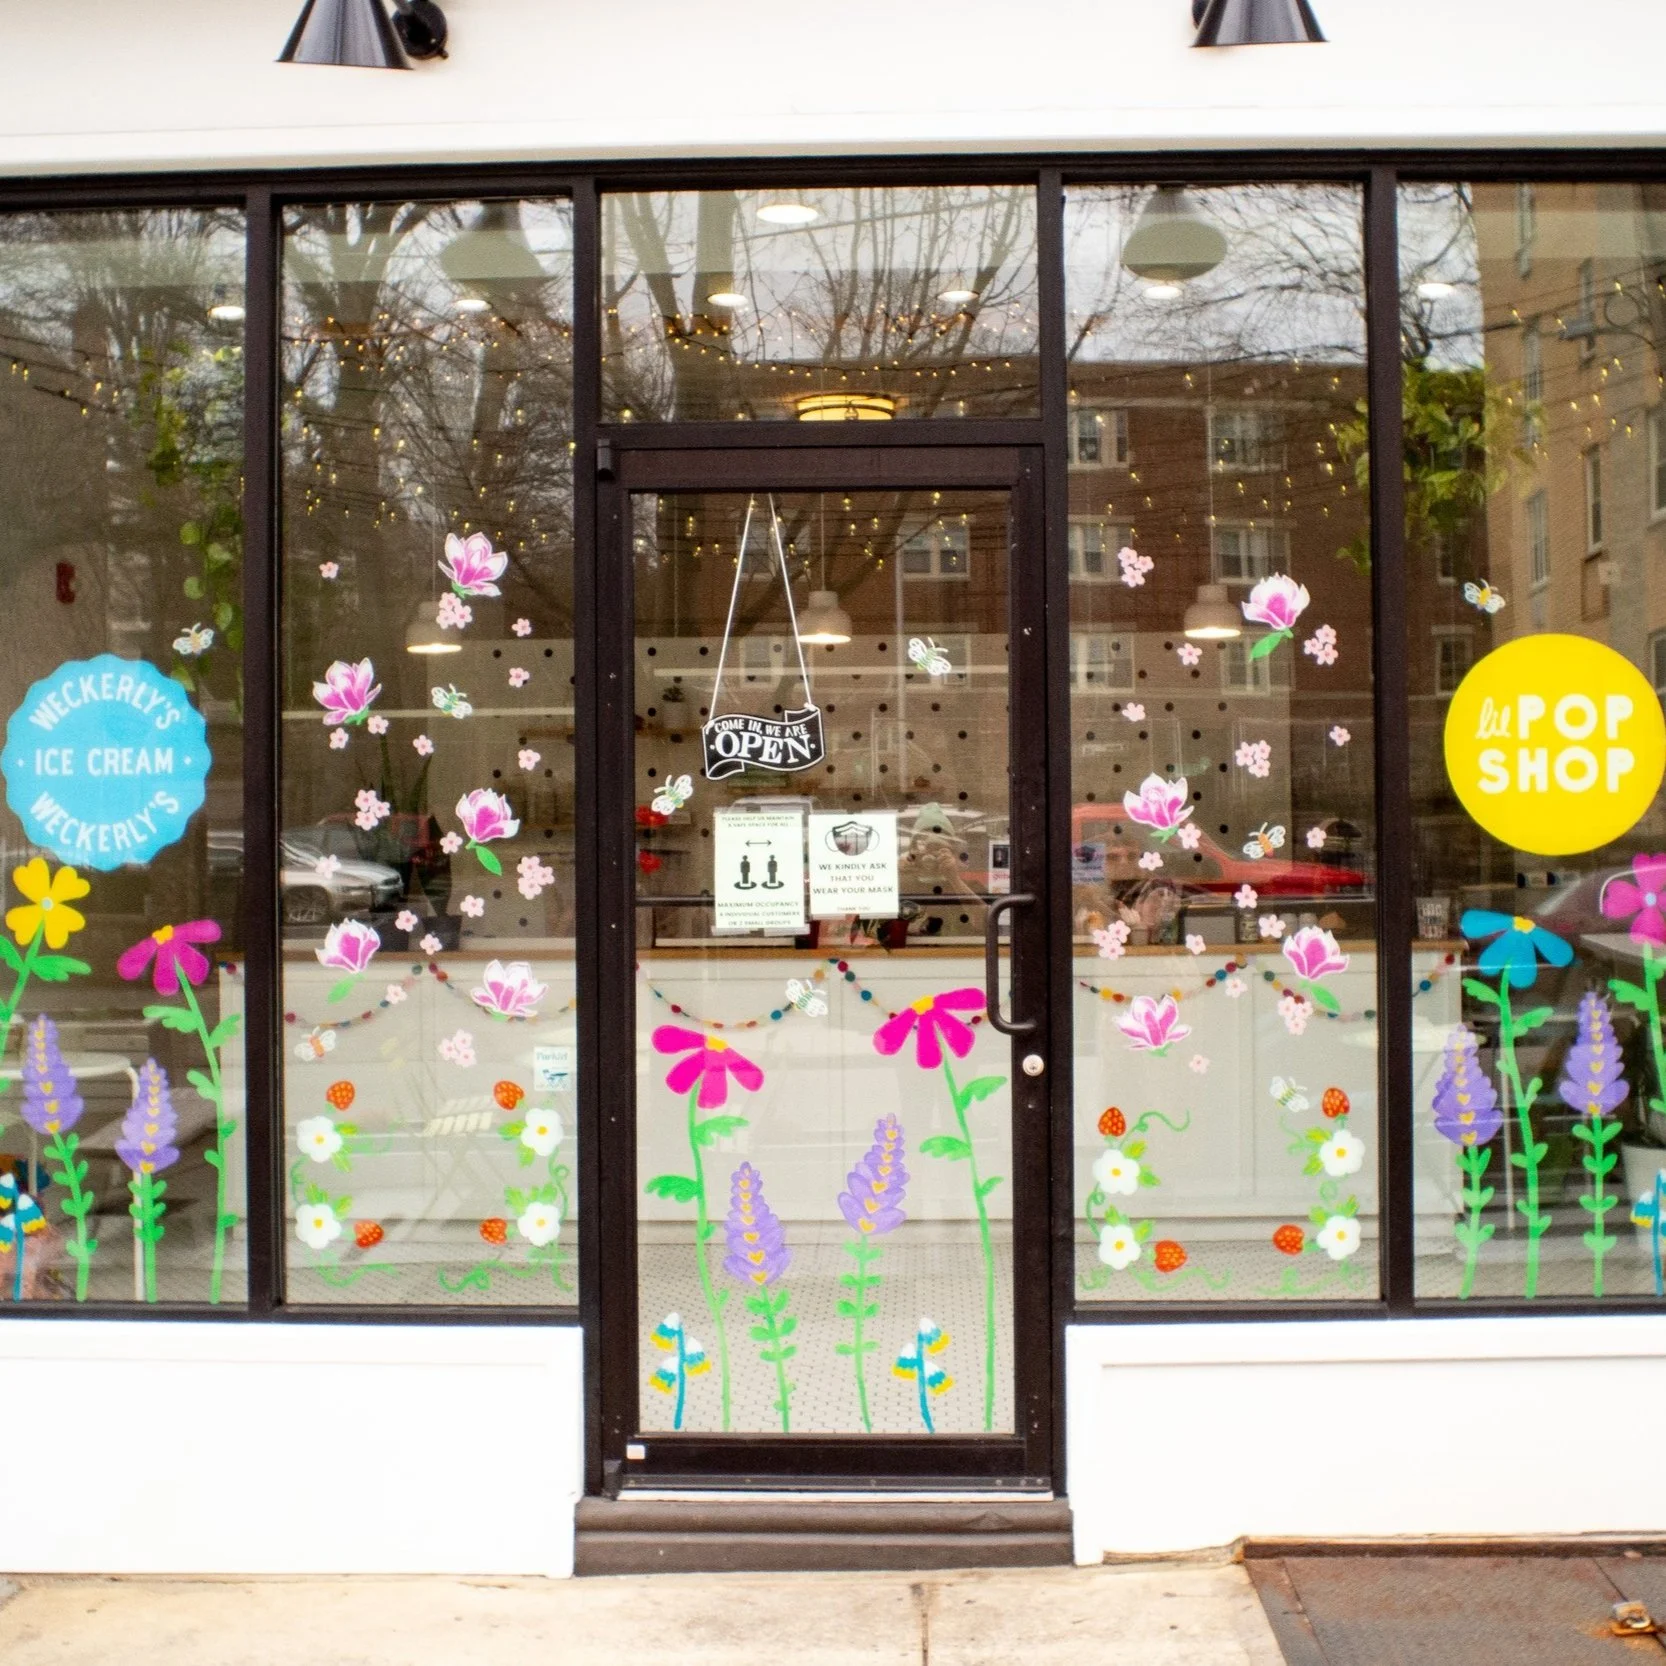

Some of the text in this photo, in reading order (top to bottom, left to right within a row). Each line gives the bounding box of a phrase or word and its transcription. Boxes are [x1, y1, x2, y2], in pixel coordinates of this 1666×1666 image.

[29, 673, 180, 731] WECKERLY'S
[1517, 693, 1634, 740] POP
[714, 719, 744, 733] COME
[765, 724, 782, 737] WE
[784, 723, 808, 737] ARE
[714, 730, 812, 764] OPEN
[35, 748, 173, 775] ICE CREAM
[1477, 745, 1636, 794] SHOP
[30, 791, 180, 850] WECKERLY'S
[869, 862, 888, 870] ASK
